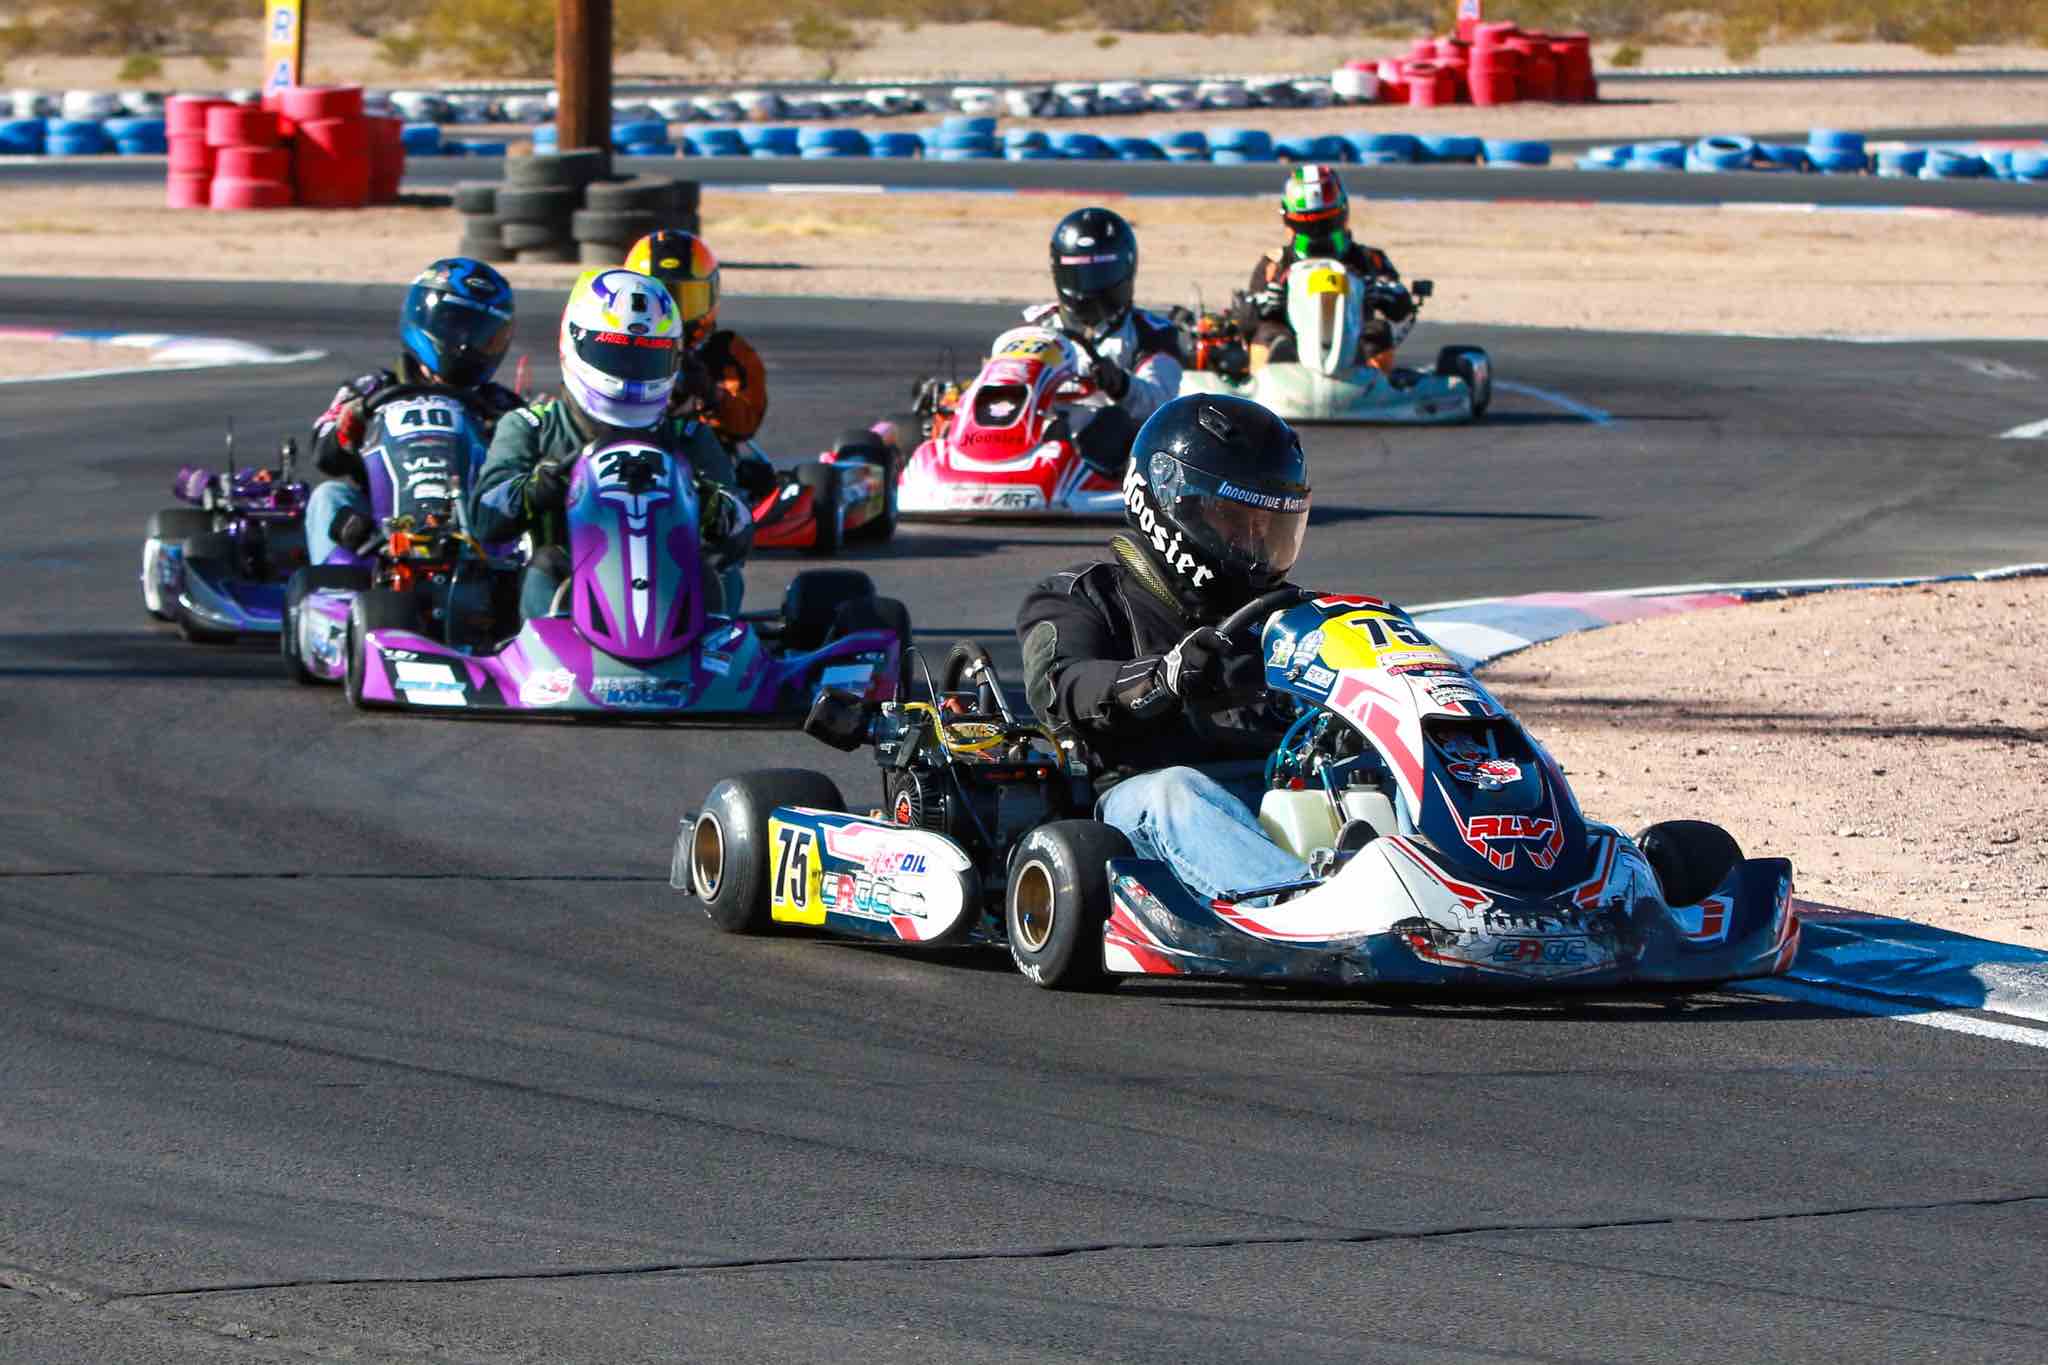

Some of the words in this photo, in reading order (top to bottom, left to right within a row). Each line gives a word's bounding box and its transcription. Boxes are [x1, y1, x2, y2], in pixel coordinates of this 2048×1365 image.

[400, 408, 453, 427] 40
[1122, 457, 1215, 588] Hoosier
[1350, 617, 1434, 648] 75
[1467, 814, 1557, 841] RLV
[774, 827, 812, 908] 75
